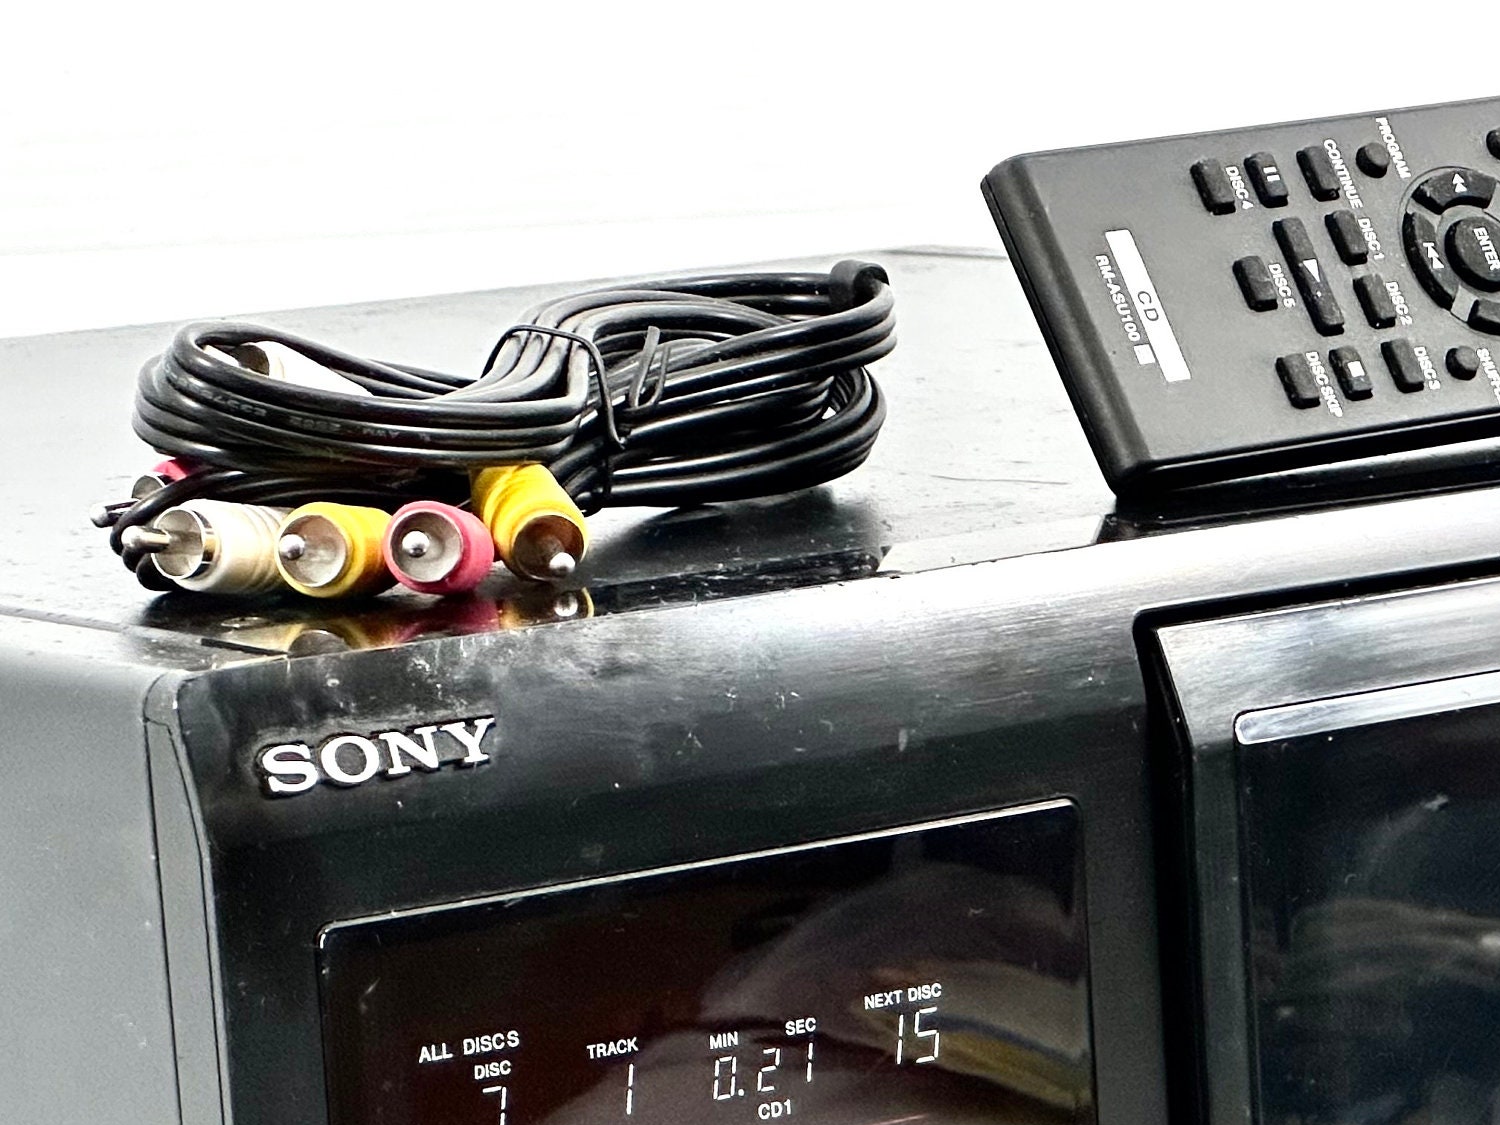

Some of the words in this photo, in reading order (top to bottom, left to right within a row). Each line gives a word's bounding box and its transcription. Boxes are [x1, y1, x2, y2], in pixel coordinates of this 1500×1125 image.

[1375, 117, 1412, 179] PROGRAM
[1225, 166, 1249, 200] DISC
[1323, 139, 1363, 209] CONTINUE
[1358, 217, 1381, 250] DISC
[1269, 263, 1292, 297] DISC
[1095, 254, 1141, 342] RM-ASU100
[1137, 290, 1160, 322] CD
[1385, 281, 1410, 315] DISC
[1414, 346, 1436, 379] DISC
[1305, 351, 1329, 386] DISC
[1320, 385, 1344, 417] SKIP
[261, 717, 496, 793] SONY
[864, 989, 903, 1011] NEXT
[907, 982, 943, 1002] DISC
[709, 1030, 740, 1051] MIN
[785, 1016, 818, 1036] SEC
[896, 1006, 941, 1065] 15
[418, 1043, 454, 1064] ALL
[462, 1030, 521, 1056] DISCS
[586, 1036, 640, 1061] TRACK
[474, 1059, 512, 1080] DISC
[625, 1063, 635, 1117] 1
[756, 1098, 793, 1122] CD1
